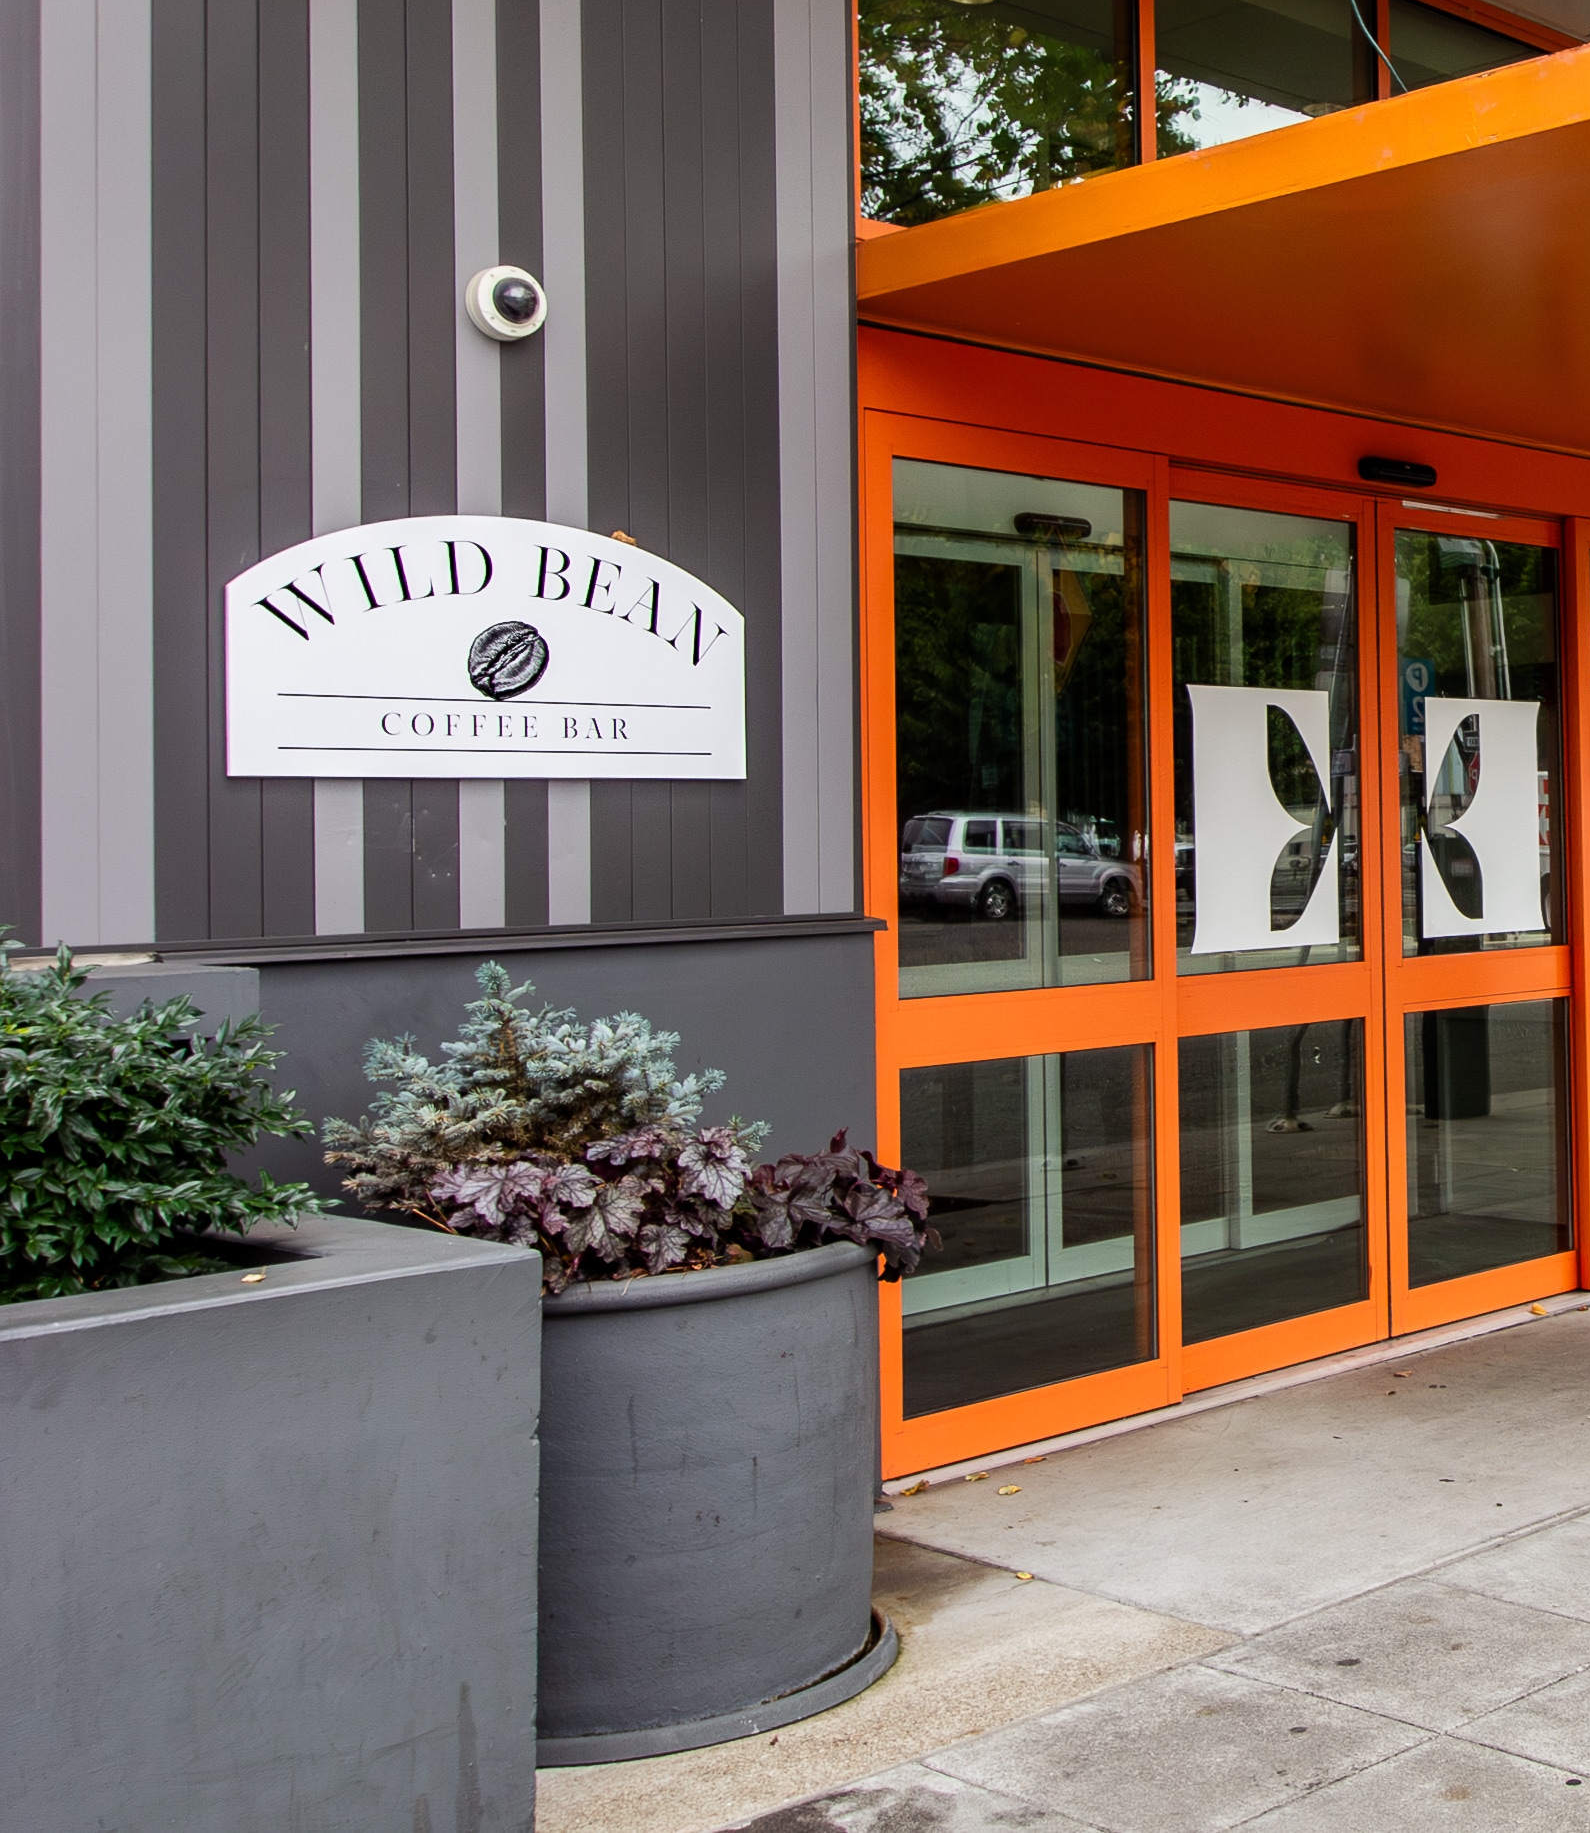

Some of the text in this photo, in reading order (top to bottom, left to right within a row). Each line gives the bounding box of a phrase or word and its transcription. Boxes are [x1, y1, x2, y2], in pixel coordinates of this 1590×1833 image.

[251, 539, 730, 667] WILD BEAN
[381, 712, 628, 740] COFFEE BAR
